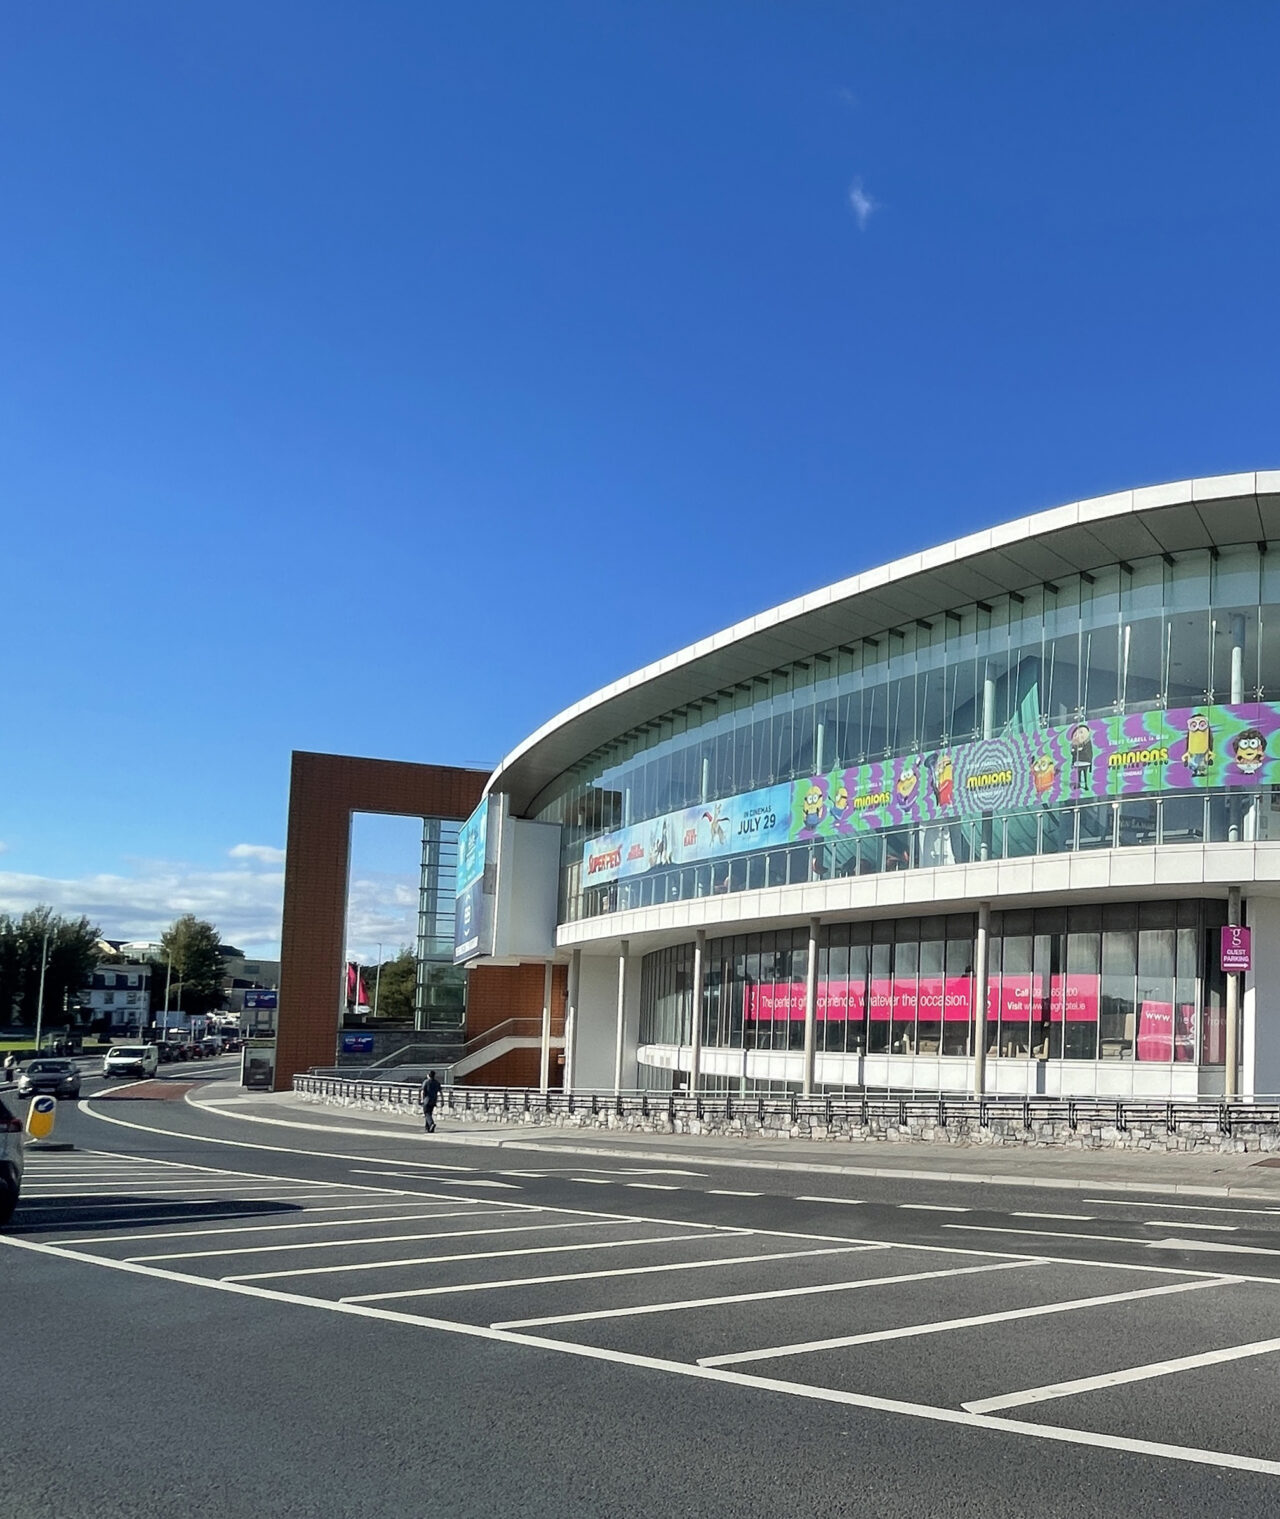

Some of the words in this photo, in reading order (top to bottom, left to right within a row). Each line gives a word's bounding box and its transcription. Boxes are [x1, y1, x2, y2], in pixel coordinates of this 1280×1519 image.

[738, 817, 761, 835] JULY
[764, 813, 776, 829] 29
[1015, 988, 1028, 997] Call
[762, 996, 773, 1008] The
[902, 993, 916, 1007] the
[920, 992, 969, 1007] occasion.
[1007, 1001, 1023, 1010] Visit
